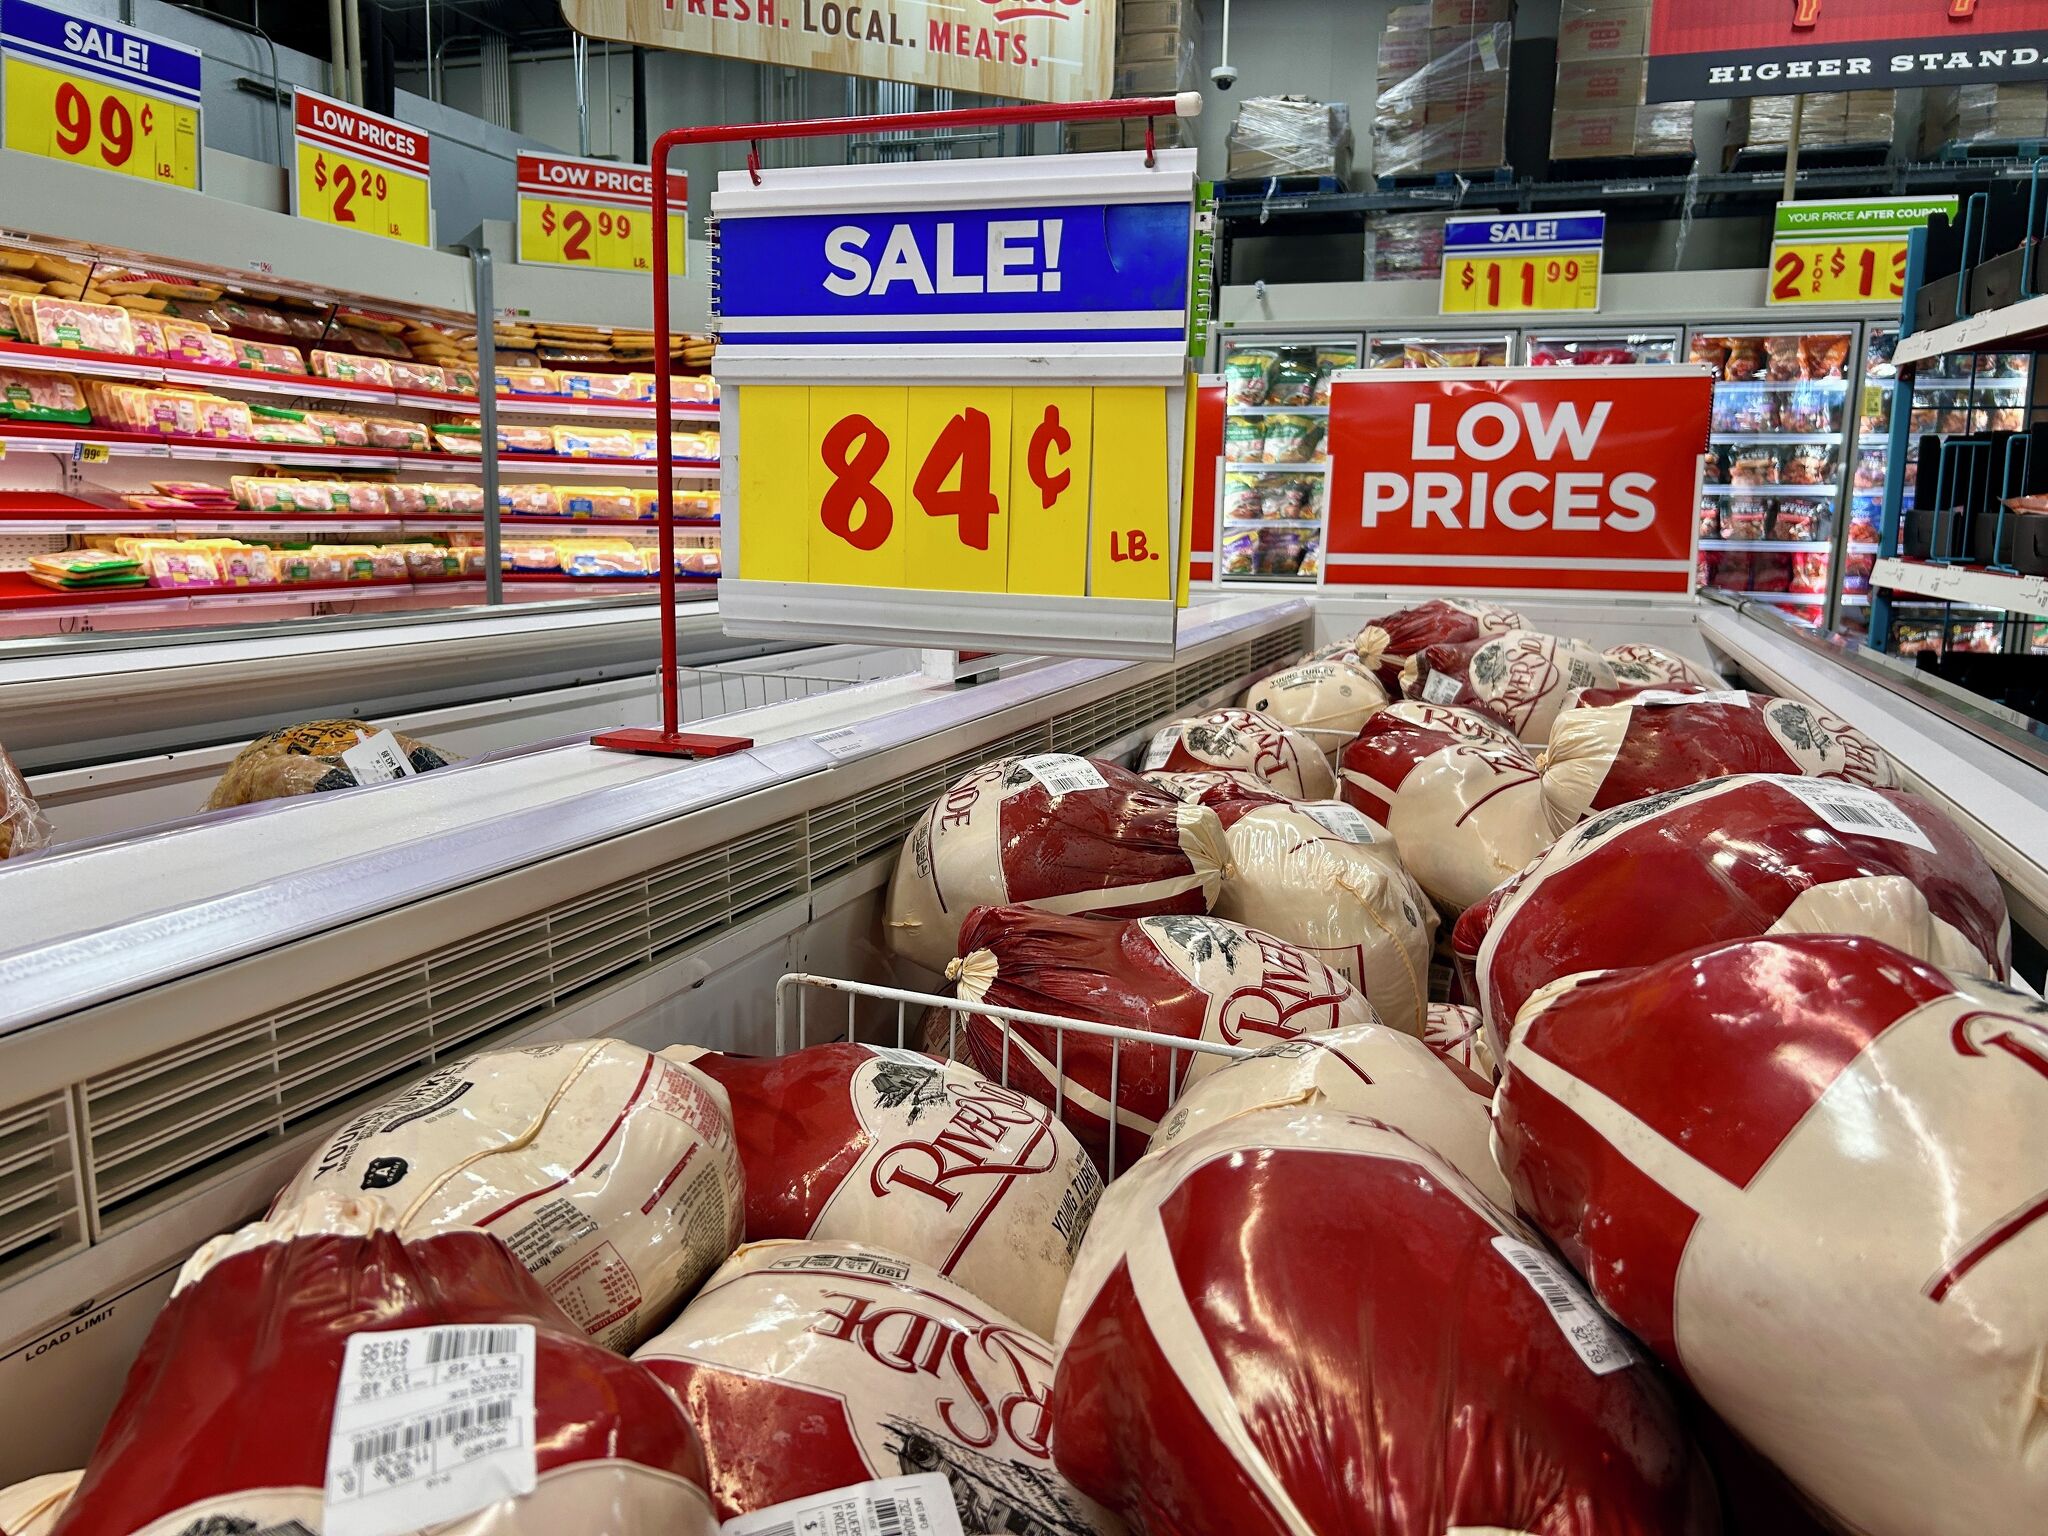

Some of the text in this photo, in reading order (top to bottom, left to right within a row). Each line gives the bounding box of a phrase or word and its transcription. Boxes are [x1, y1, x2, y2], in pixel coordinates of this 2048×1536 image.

[64, 20, 149, 73] SALE!
[804, 2, 916, 48] LOCAL.
[929, 19, 1039, 67] MEATS.
[1708, 48, 2048, 84] HIGHER STAND
[313, 105, 416, 156] LOW PRICES
[539, 164, 669, 194] LOW PRICE
[1489, 221, 1558, 242] SALE!
[1788, 212, 1819, 223] YOUR
[1822, 211, 1854, 222] PRICE
[1857, 209, 1894, 220] AFTER
[822, 219, 1064, 297] SALE!
[1773, 252, 1805, 299] 2
[1411, 401, 1612, 461] LOW
[1361, 471, 1659, 533] PRICES
[1111, 530, 1160, 562] LB.
[313, 1105, 384, 1181] YOUNG
[1052, 1190, 1077, 1241] YOUNG
[25, 1307, 115, 1362] LOAD LIMIT
